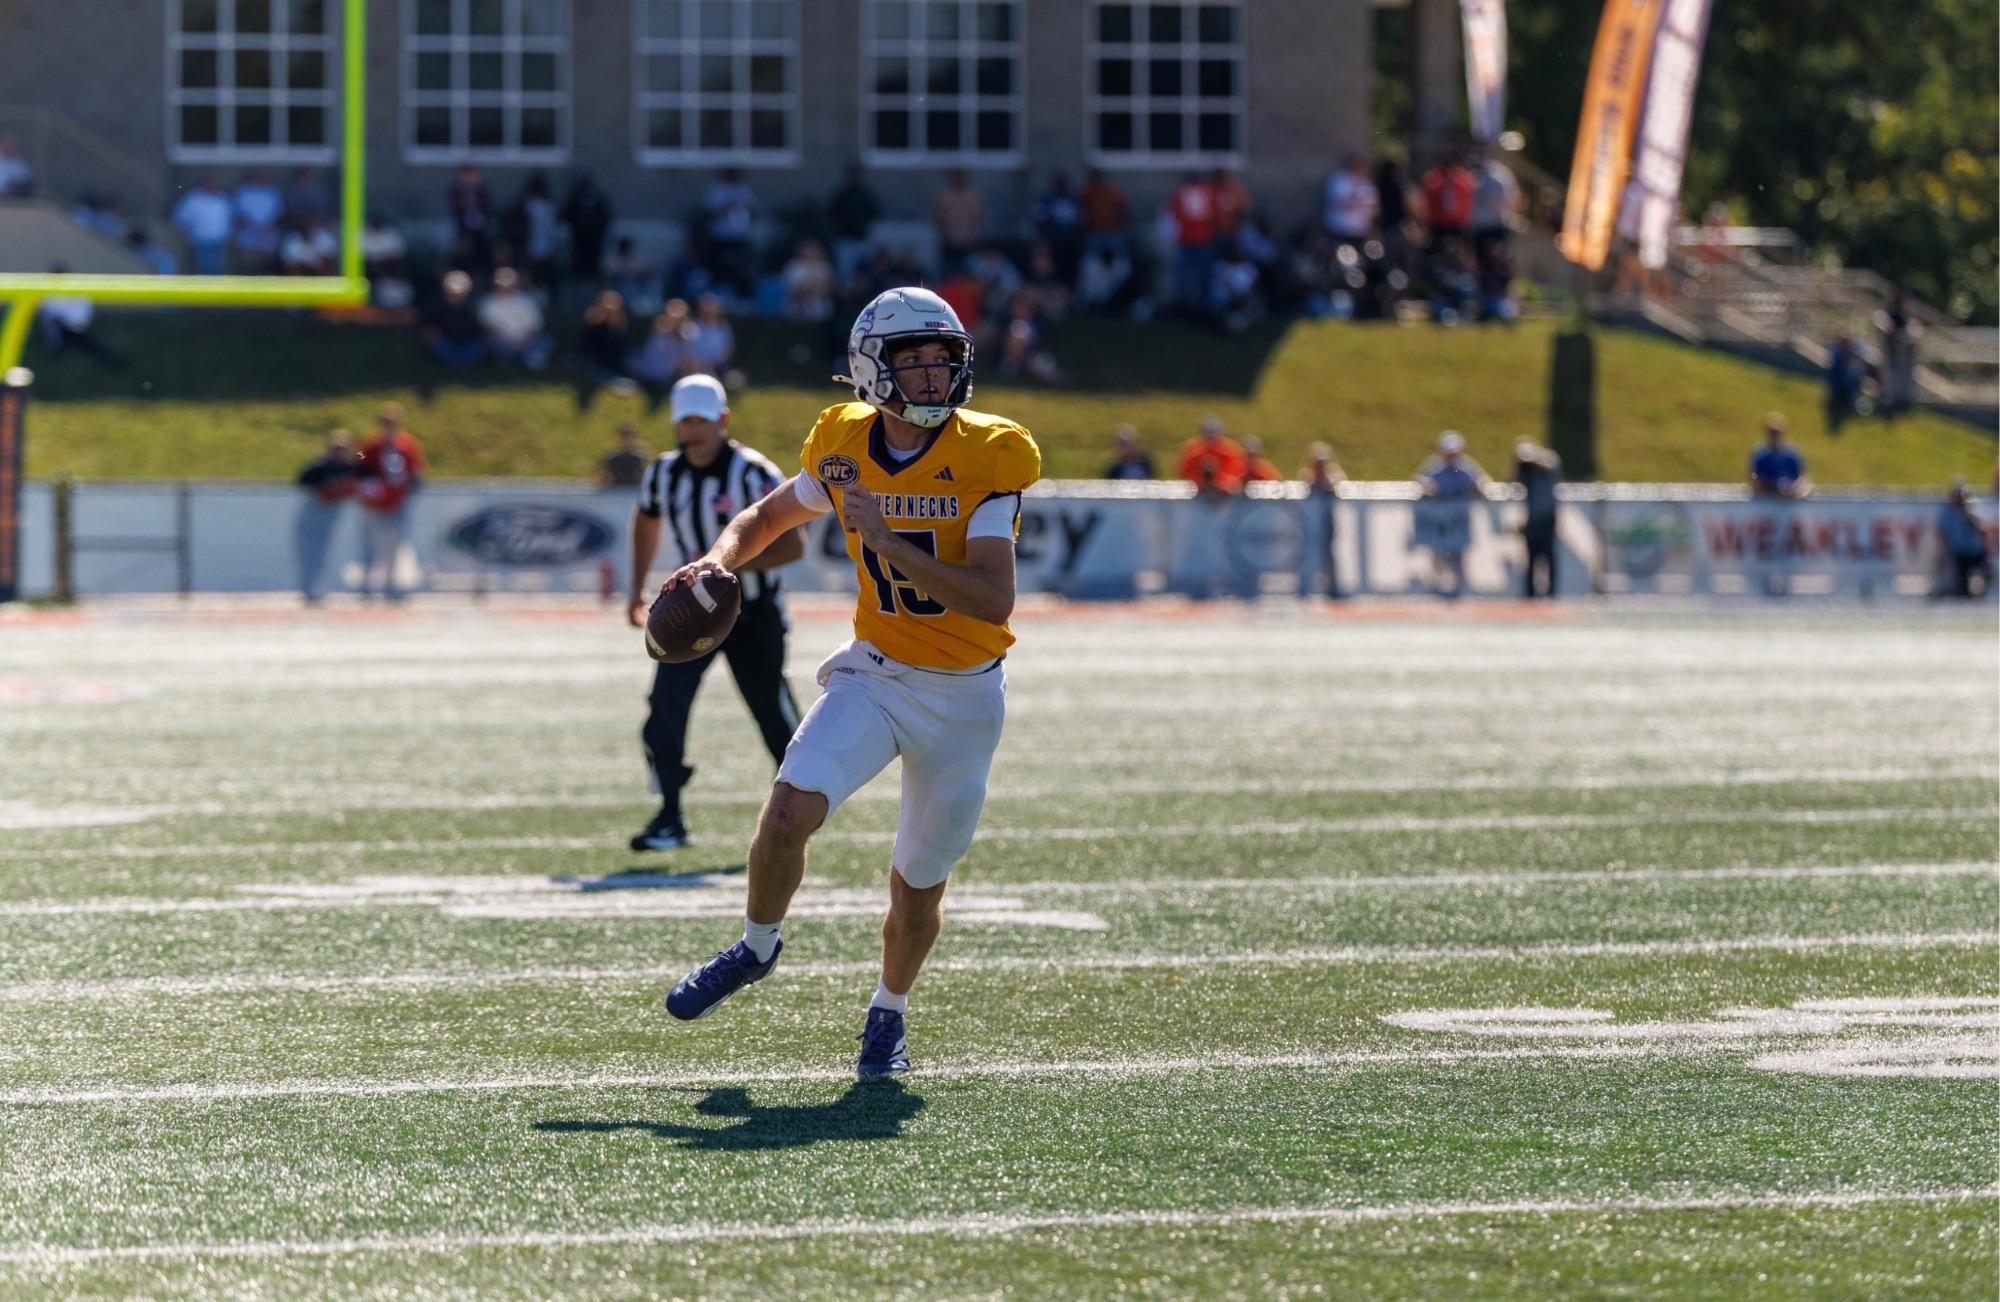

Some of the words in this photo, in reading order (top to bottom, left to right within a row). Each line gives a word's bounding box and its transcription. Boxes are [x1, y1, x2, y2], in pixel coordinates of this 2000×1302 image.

[824, 465, 850, 479] OVC
[870, 492, 959, 519] ERNECKS
[1705, 516, 1926, 562] WEAKLEY
